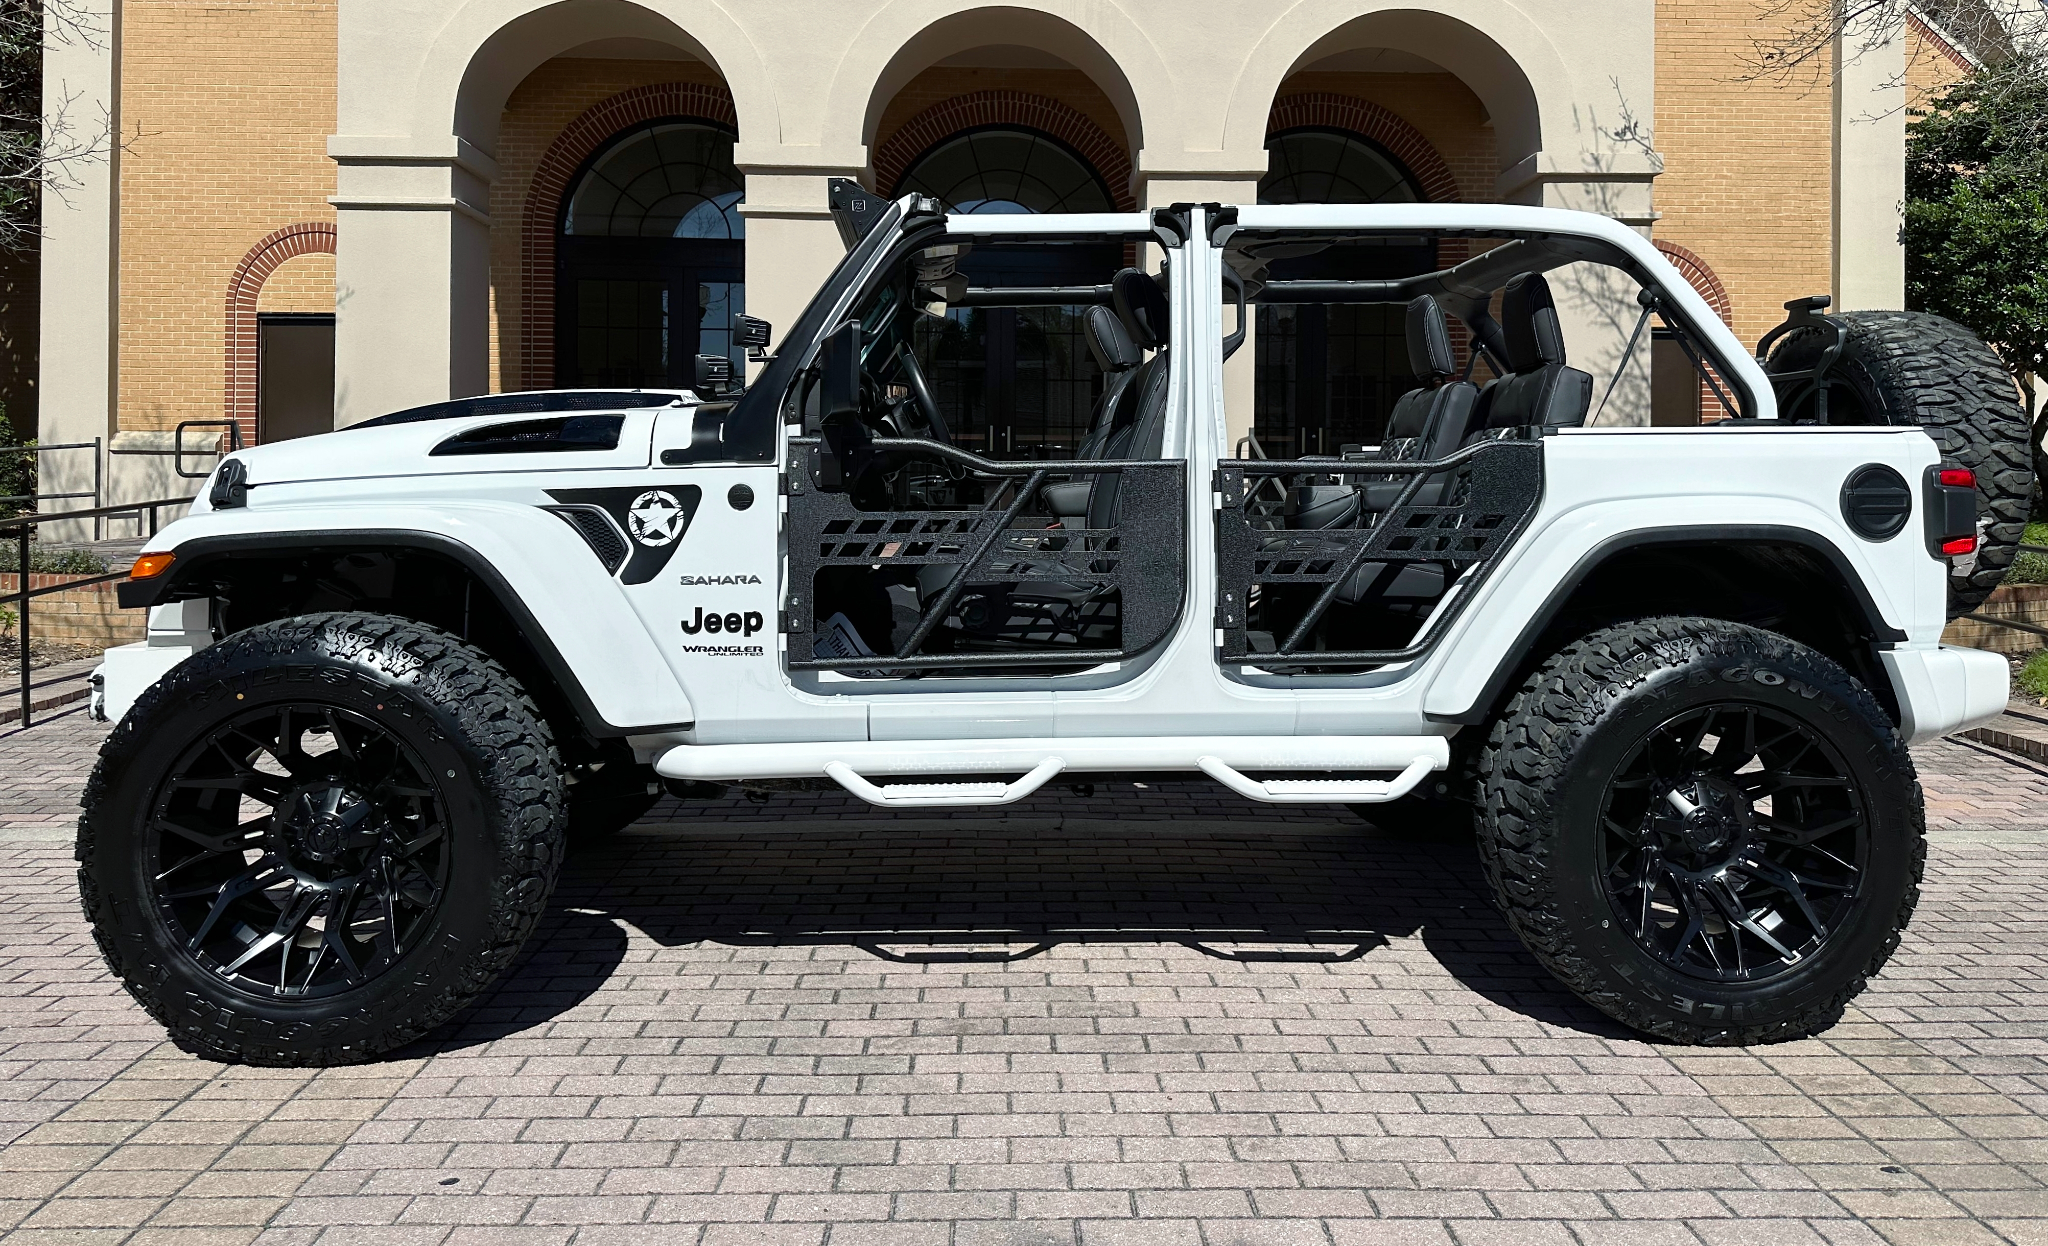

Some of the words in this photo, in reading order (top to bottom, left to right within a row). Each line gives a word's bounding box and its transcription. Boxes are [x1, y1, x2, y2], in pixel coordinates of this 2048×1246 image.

[680, 575, 762, 586] SAHARA
[681, 606, 764, 638] Jeep
[682, 645, 764, 653] WRANGLER
[187, 663, 446, 744] MILESTAR
[1607, 666, 1857, 737] PATAGONIA
[183, 932, 463, 1043] PATAGONIA
